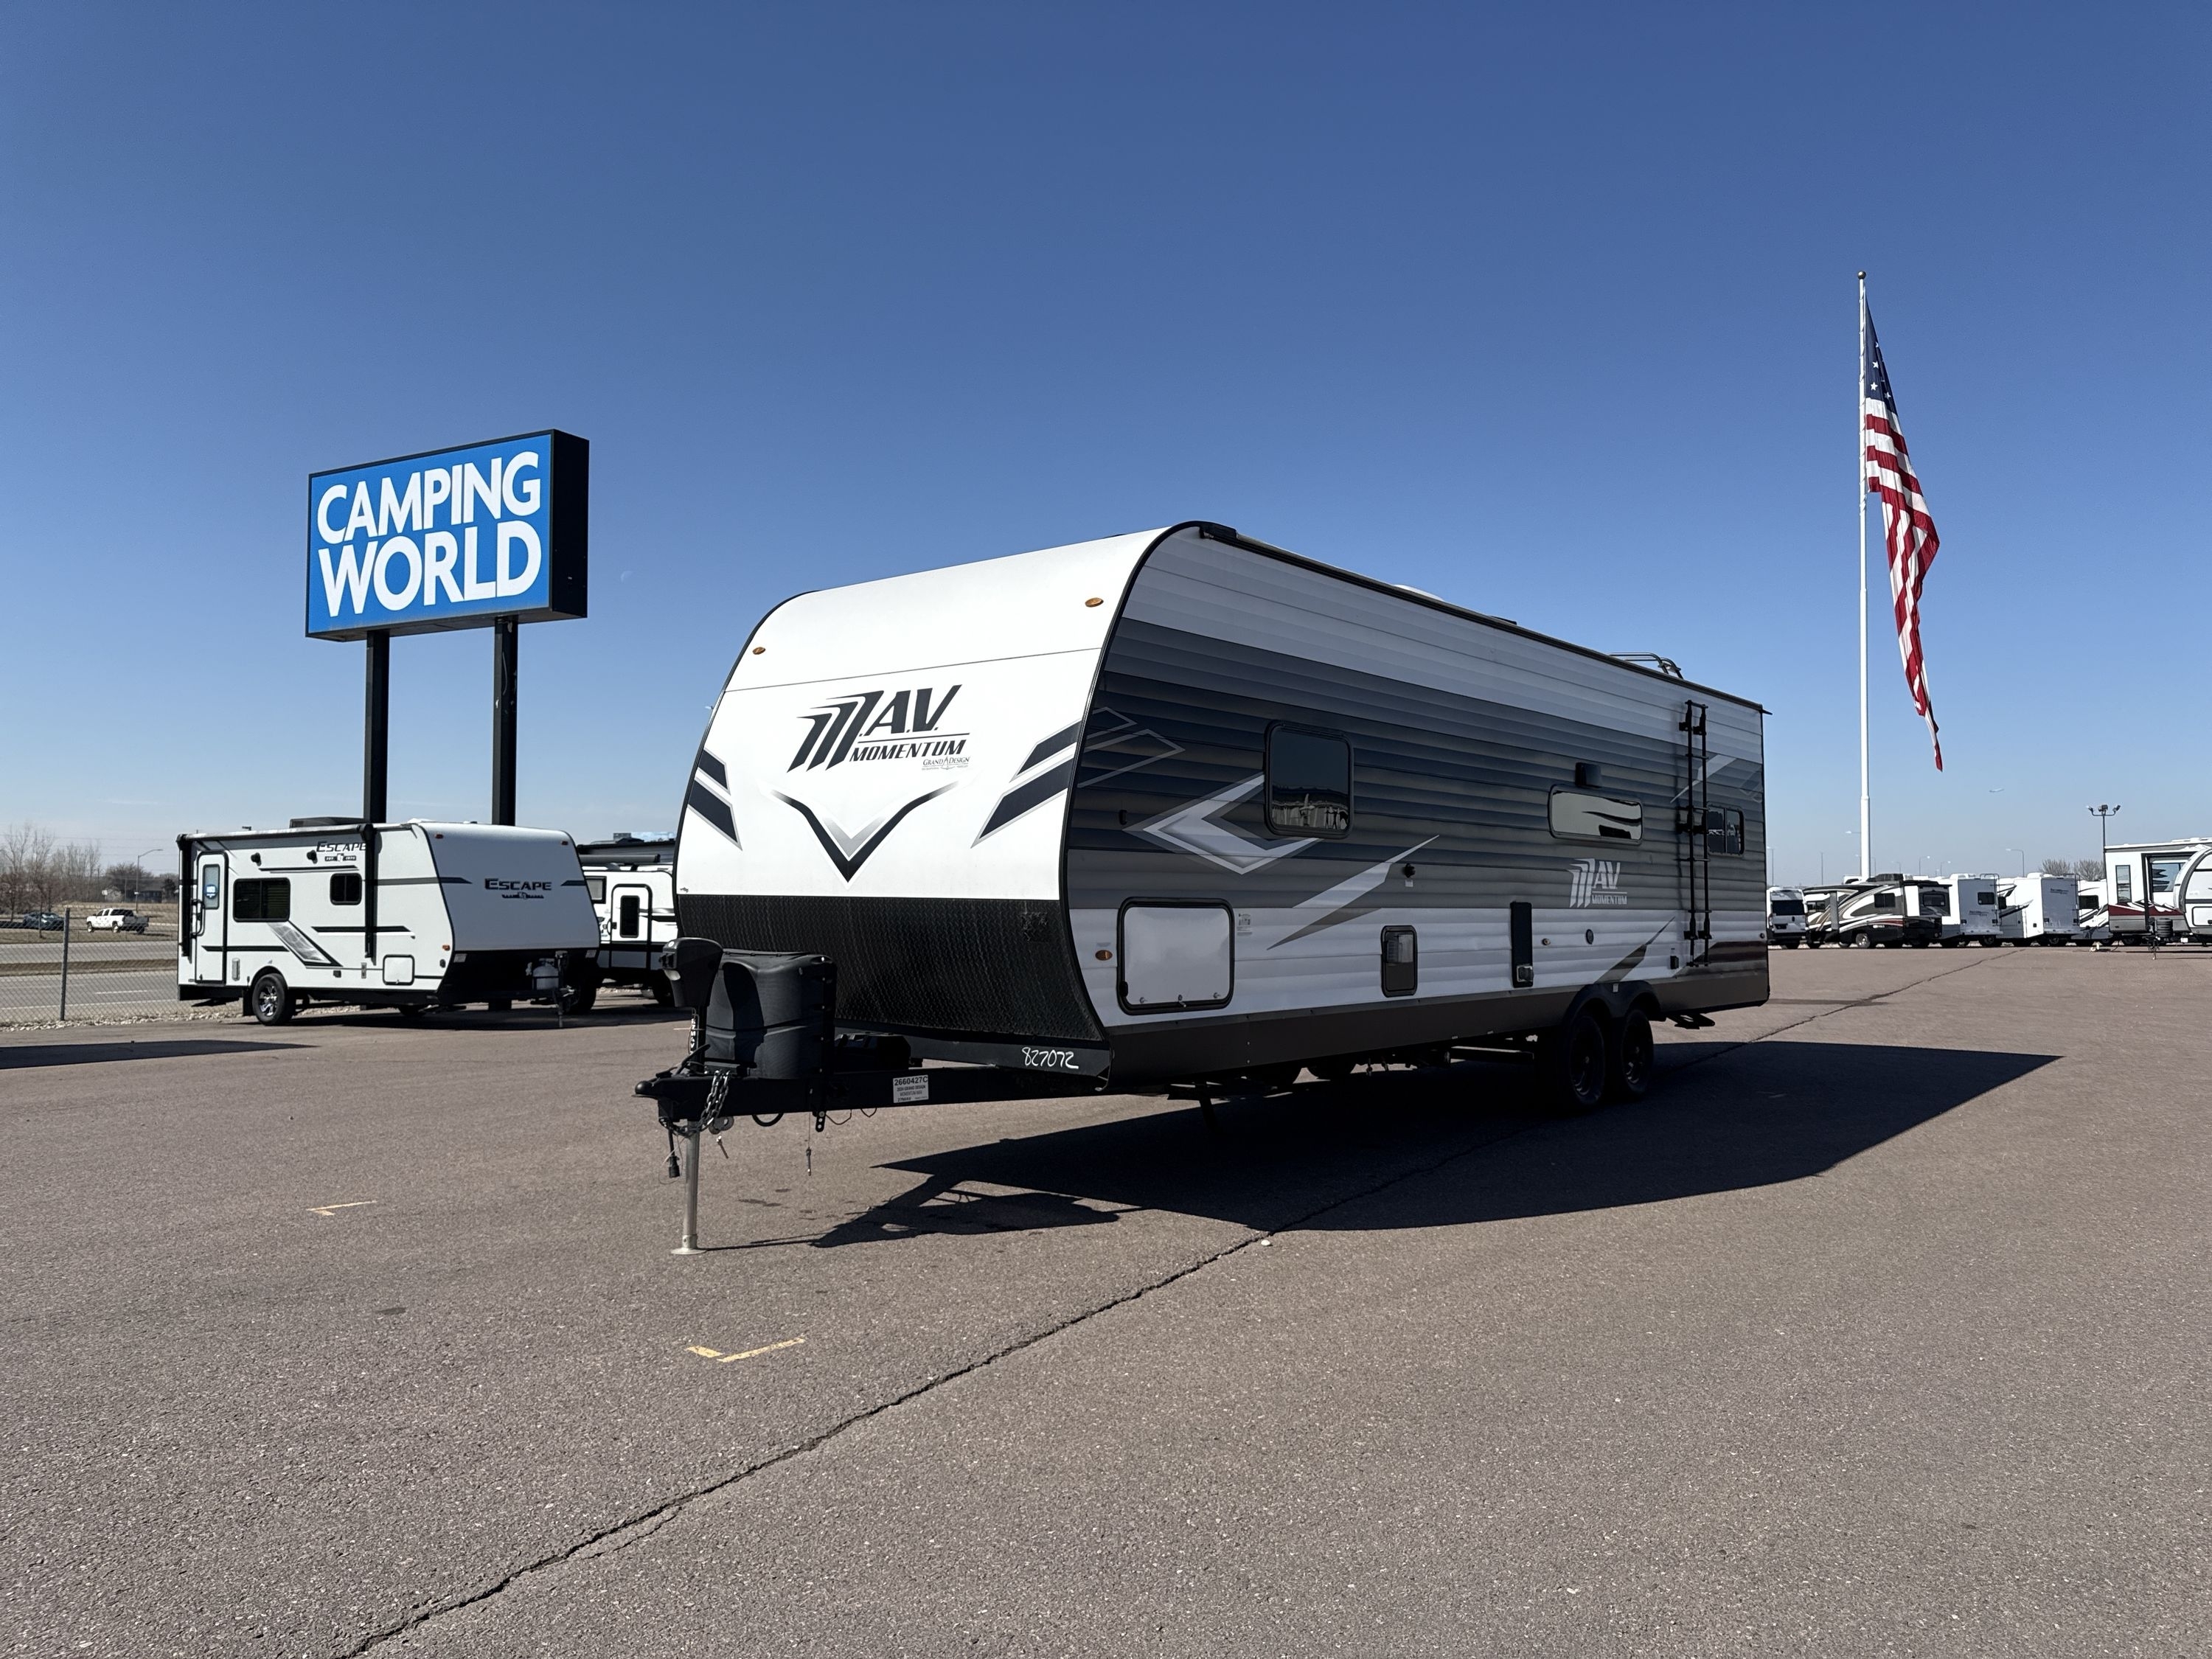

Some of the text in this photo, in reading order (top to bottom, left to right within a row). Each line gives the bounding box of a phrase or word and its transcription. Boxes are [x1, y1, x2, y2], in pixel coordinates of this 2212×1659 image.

[317, 451, 540, 544] CAMPING
[318, 520, 542, 617] WORLD
[849, 739, 967, 762] MOMENTUM
[484, 878, 552, 891] ESCAPE
[1591, 894, 1627, 905] MOMENTUM
[1022, 1046, 1079, 1070] 827072
[894, 1076, 928, 1086] 2660427C
